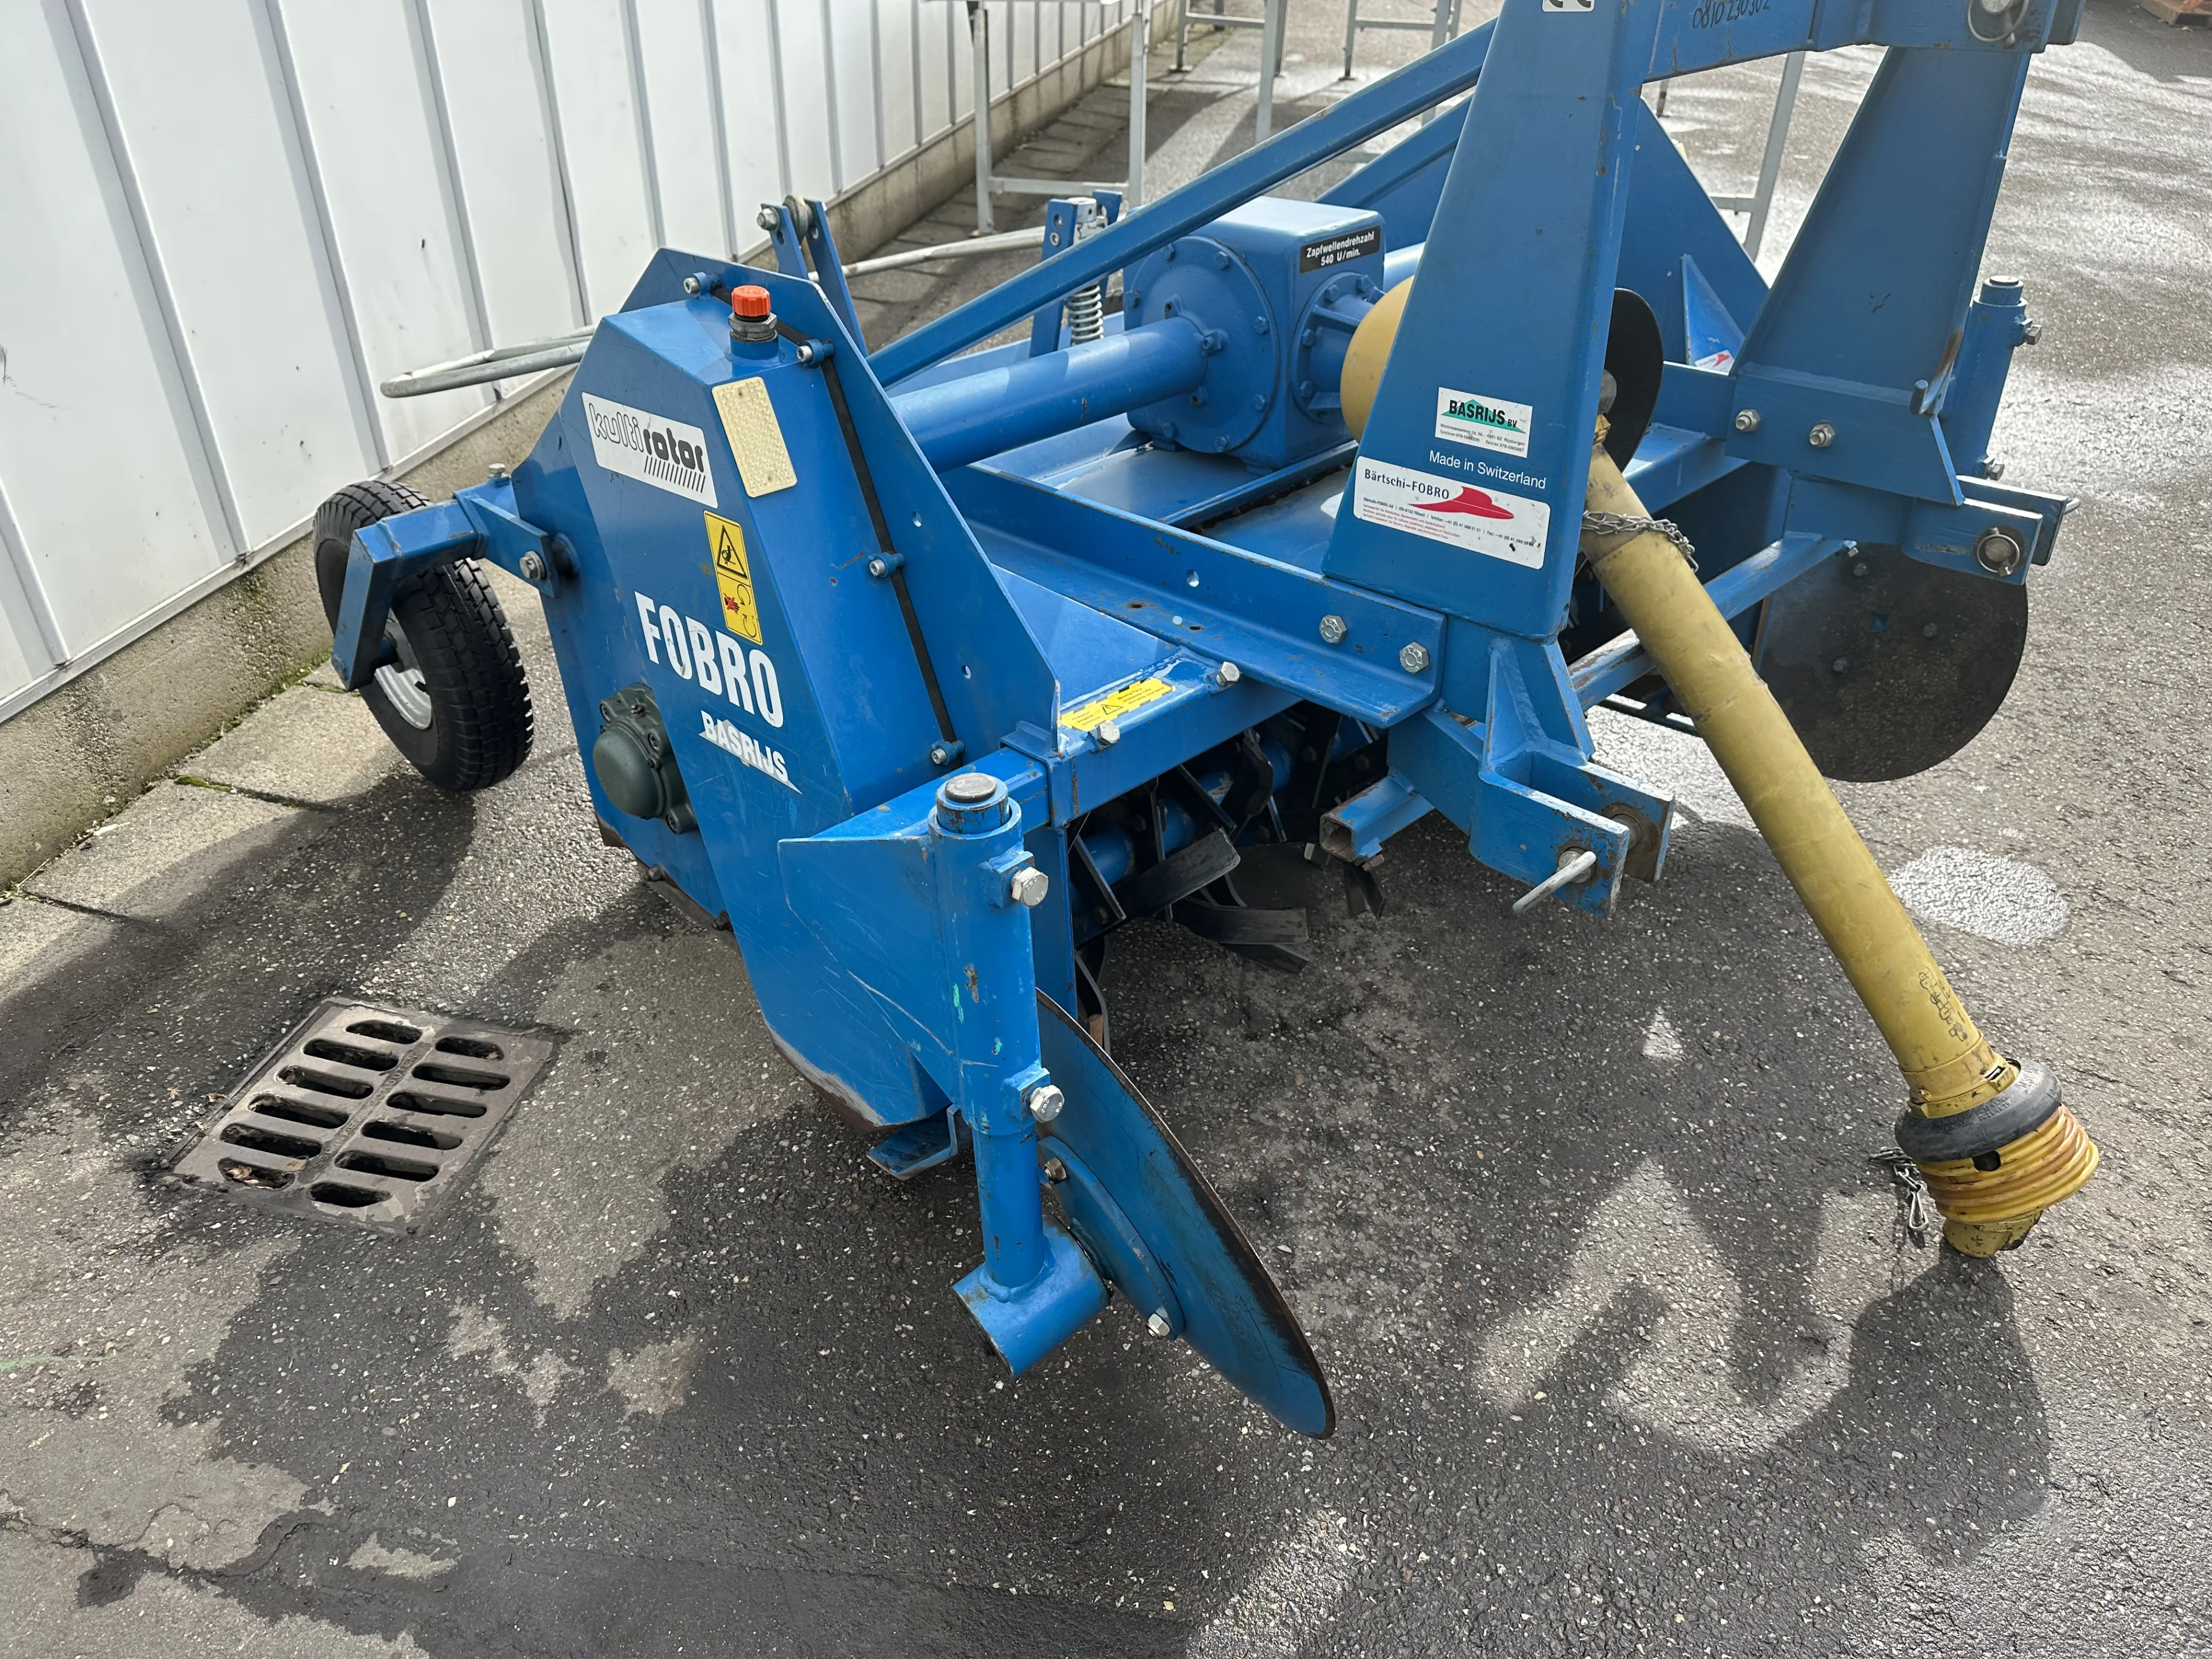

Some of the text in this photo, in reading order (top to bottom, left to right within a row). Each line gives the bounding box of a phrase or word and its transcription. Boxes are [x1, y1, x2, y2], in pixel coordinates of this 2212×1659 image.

[1306, 231, 1374, 257] Zapfwellendrehzahl
[1321, 248, 1361, 266] 540 U/min.
[1449, 400, 1517, 427] BASRIJS BV
[1365, 469, 1450, 499] Bärtschi-FOBRO
[1429, 450, 1547, 490] Made in Switzerland
[634, 591, 783, 728] FOBRO
[700, 710, 788, 782] BASRIJS
